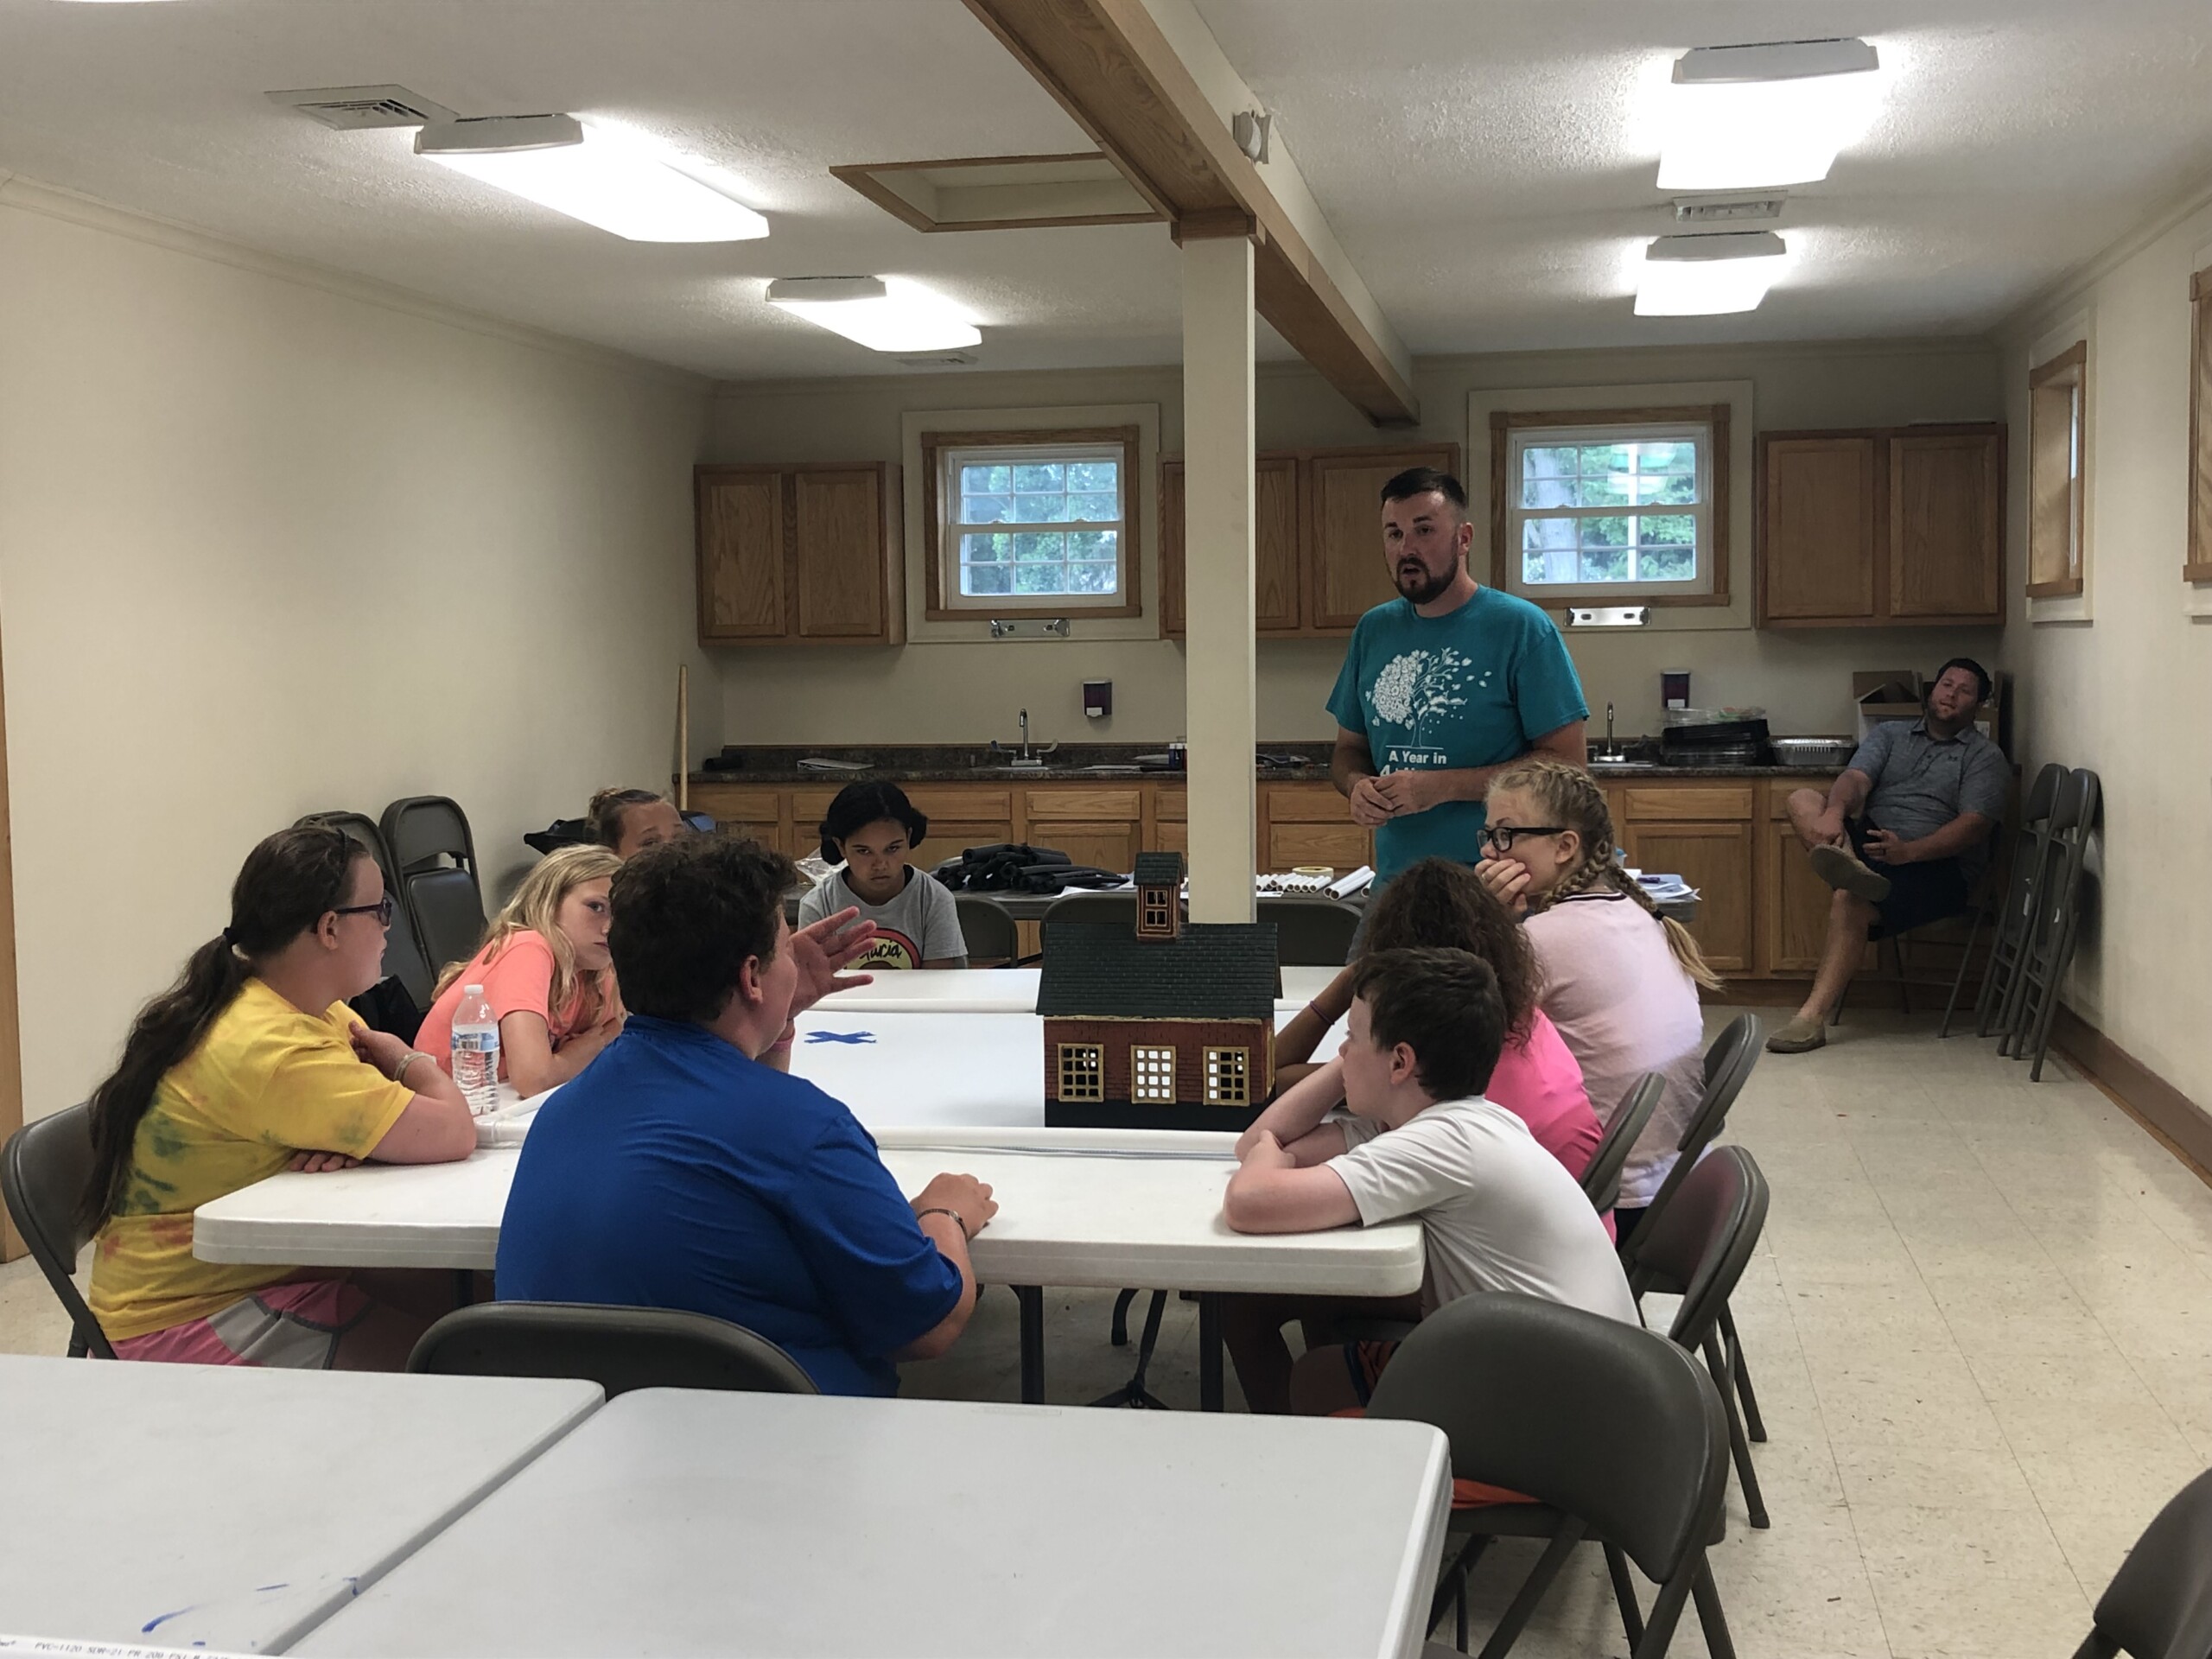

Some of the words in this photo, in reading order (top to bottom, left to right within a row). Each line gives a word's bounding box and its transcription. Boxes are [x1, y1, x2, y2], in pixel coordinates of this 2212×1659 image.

[1389, 750, 1399, 762] A
[1402, 750, 1430, 764] Year
[1433, 751, 1446, 765] in
